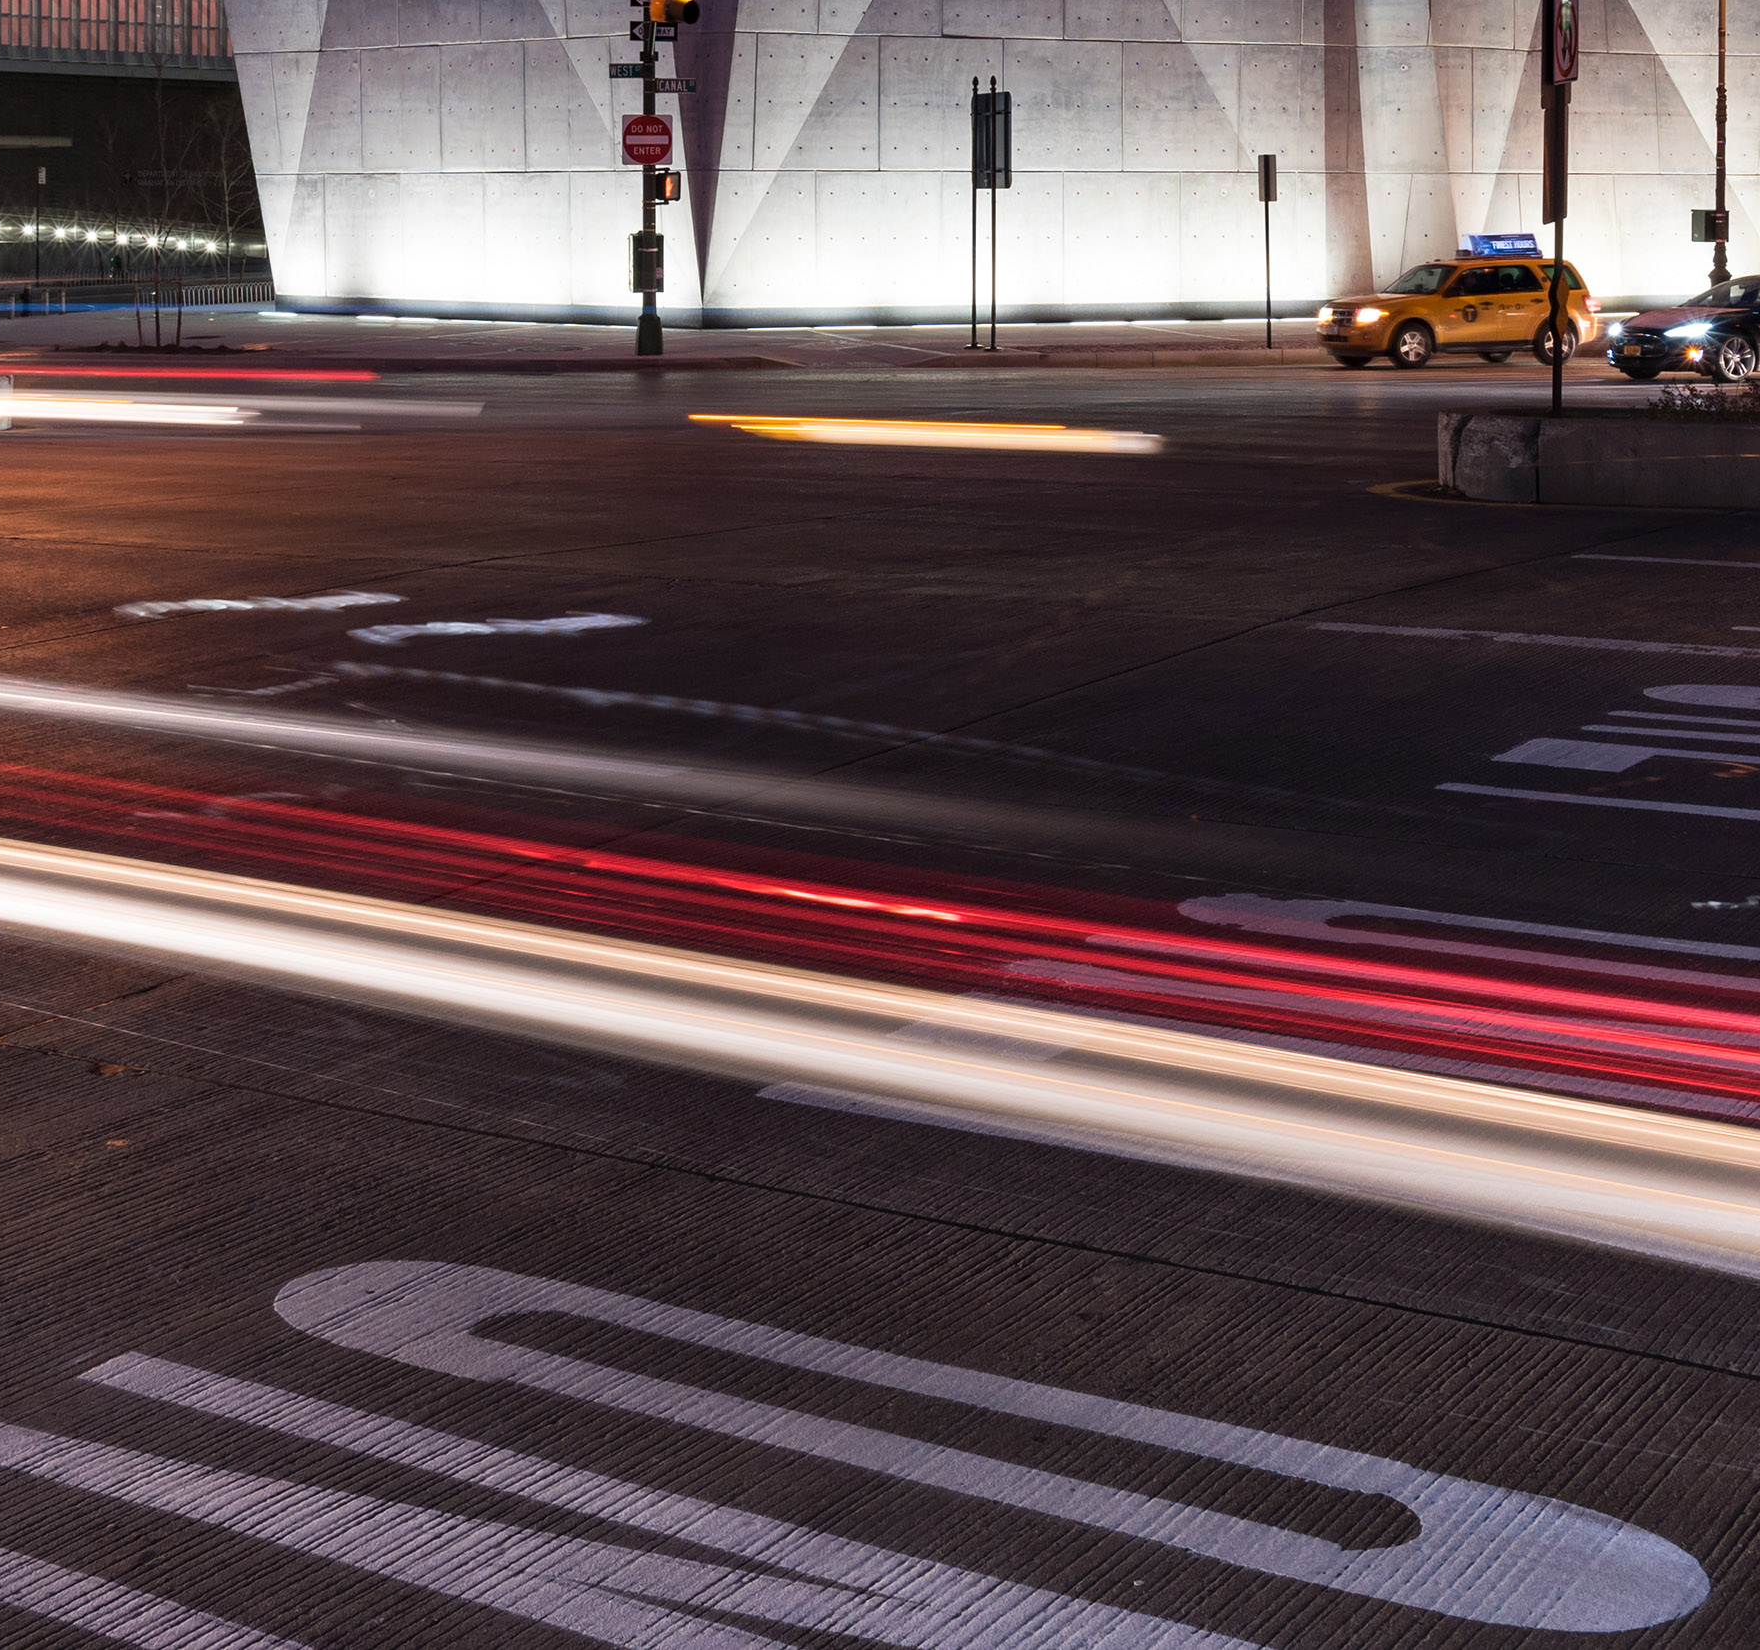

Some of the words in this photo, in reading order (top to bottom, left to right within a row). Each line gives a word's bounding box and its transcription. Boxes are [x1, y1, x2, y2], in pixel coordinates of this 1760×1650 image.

[610, 65, 634, 77] WEST
[659, 80, 688, 92] CANAL
[631, 125, 644, 133] DO
[646, 125, 663, 133] NOT
[633, 147, 662, 155] ENTER
